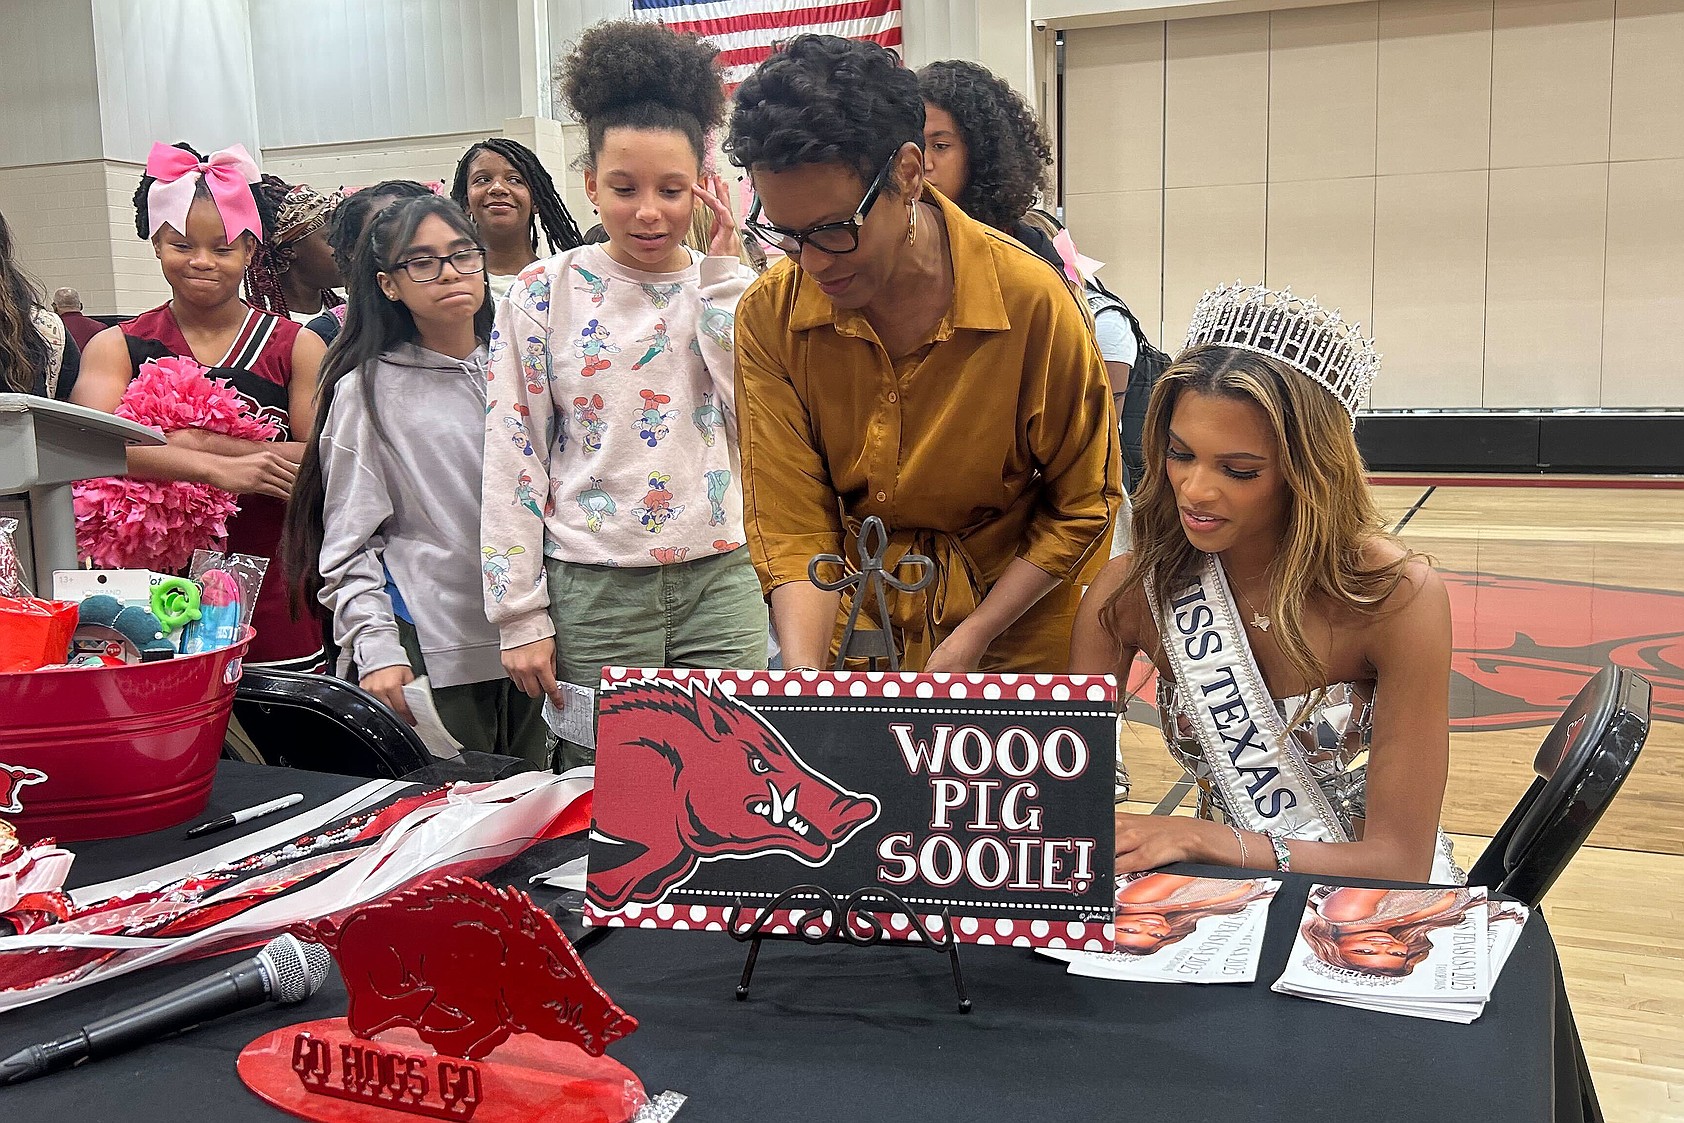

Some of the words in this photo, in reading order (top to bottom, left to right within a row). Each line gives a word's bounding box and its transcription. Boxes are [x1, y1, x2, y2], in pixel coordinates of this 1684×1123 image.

[58, 576, 74, 584] 13+
[889, 722, 1089, 781] WOOO
[1201, 666, 1297, 819] TEXAS
[929, 777, 1043, 833] PIG
[877, 832, 1097, 893] SOOIE!
[1207, 921, 1244, 942] TEXAS
[1193, 942, 1224, 956] USA
[1452, 932, 1476, 955] TEXAS
[1176, 956, 1211, 975] 2025
[1222, 958, 1248, 975] 2025
[1452, 956, 1476, 971] USA
[259, 966, 271, 992] SHURE
[1450, 972, 1476, 991] 2025
[292, 1031, 332, 1079] GO
[339, 1042, 429, 1102] HOGS
[438, 1061, 484, 1109] GO
